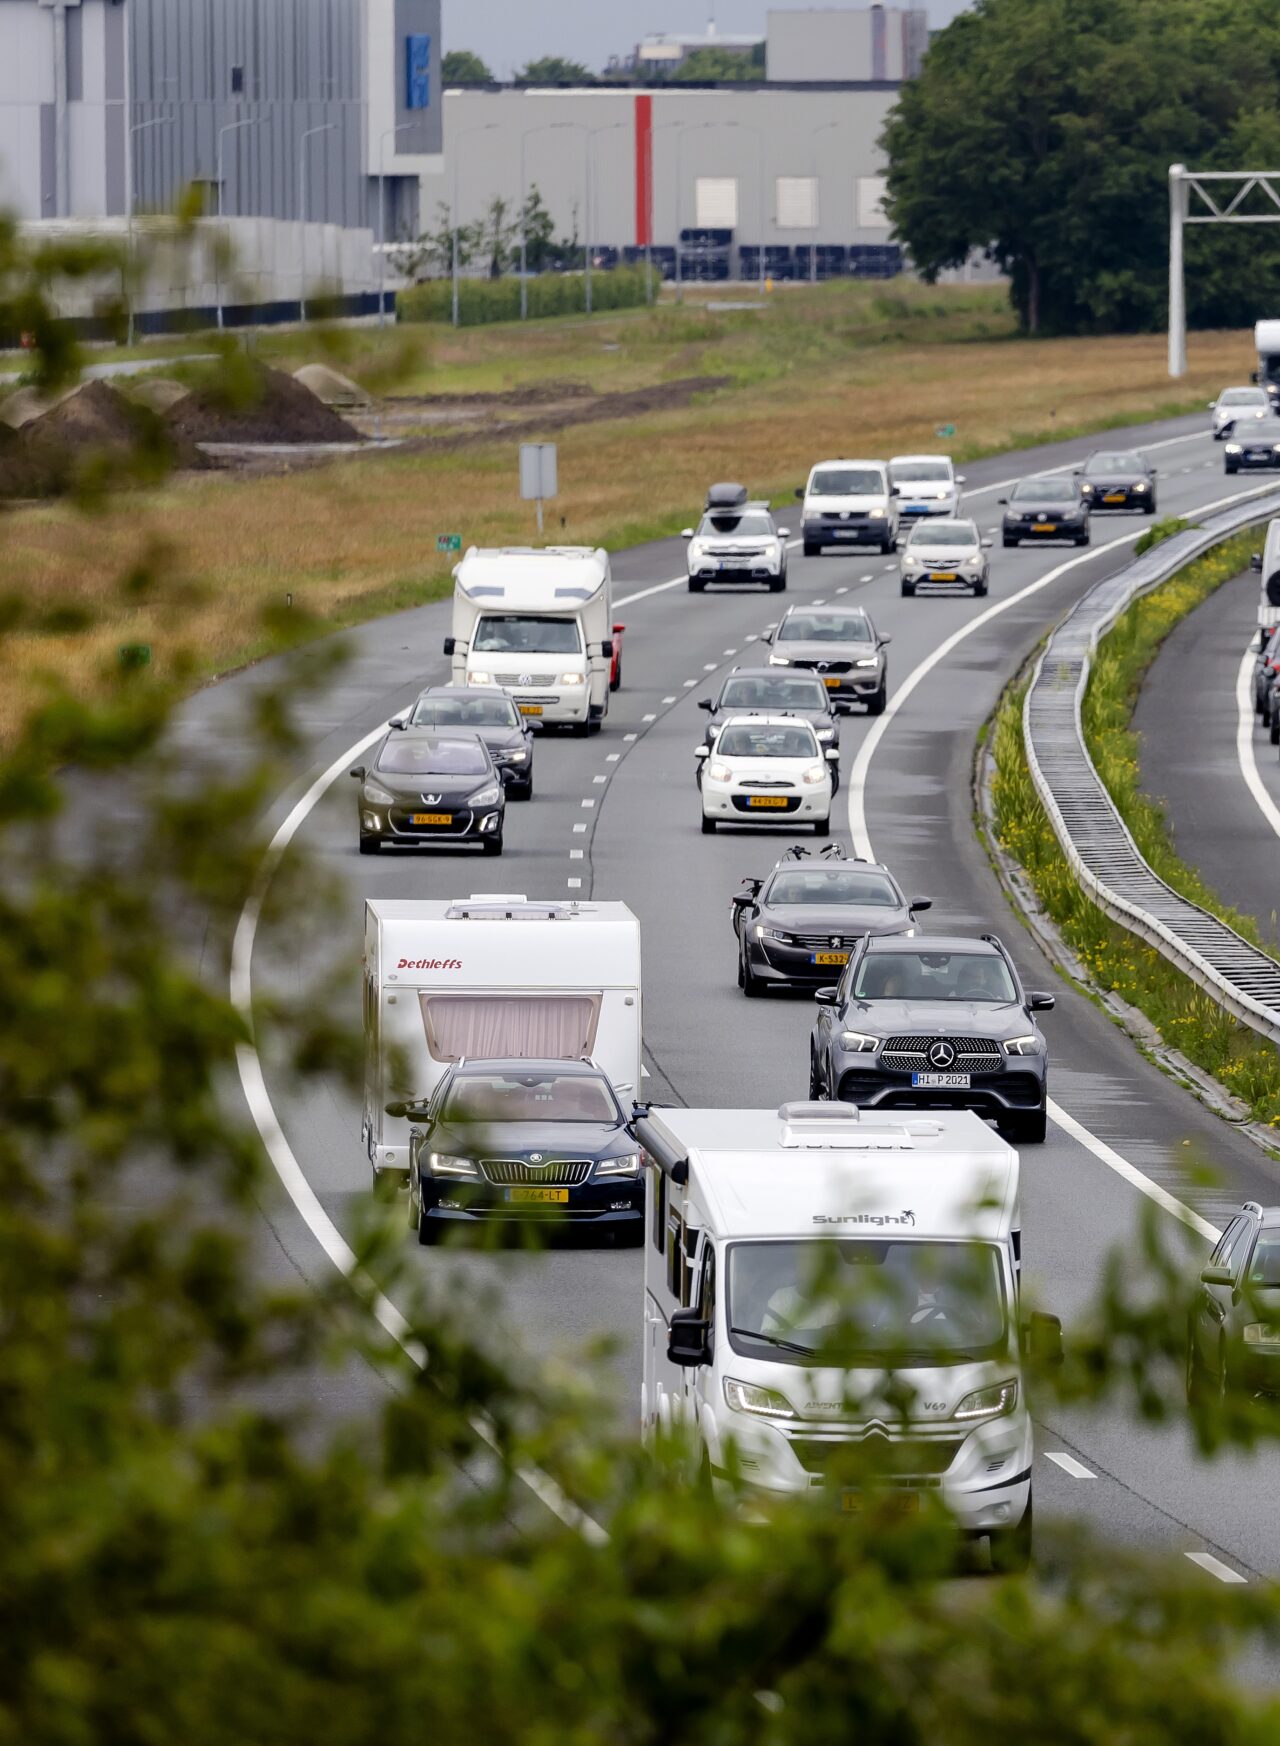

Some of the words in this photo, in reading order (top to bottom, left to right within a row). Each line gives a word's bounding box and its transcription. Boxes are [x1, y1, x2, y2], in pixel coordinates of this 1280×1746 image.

[397, 958, 463, 969] Dethleffs
[945, 1075, 969, 1085] 2021
[812, 1214, 909, 1226] Sunlight
[923, 1402, 947, 1411] V69
